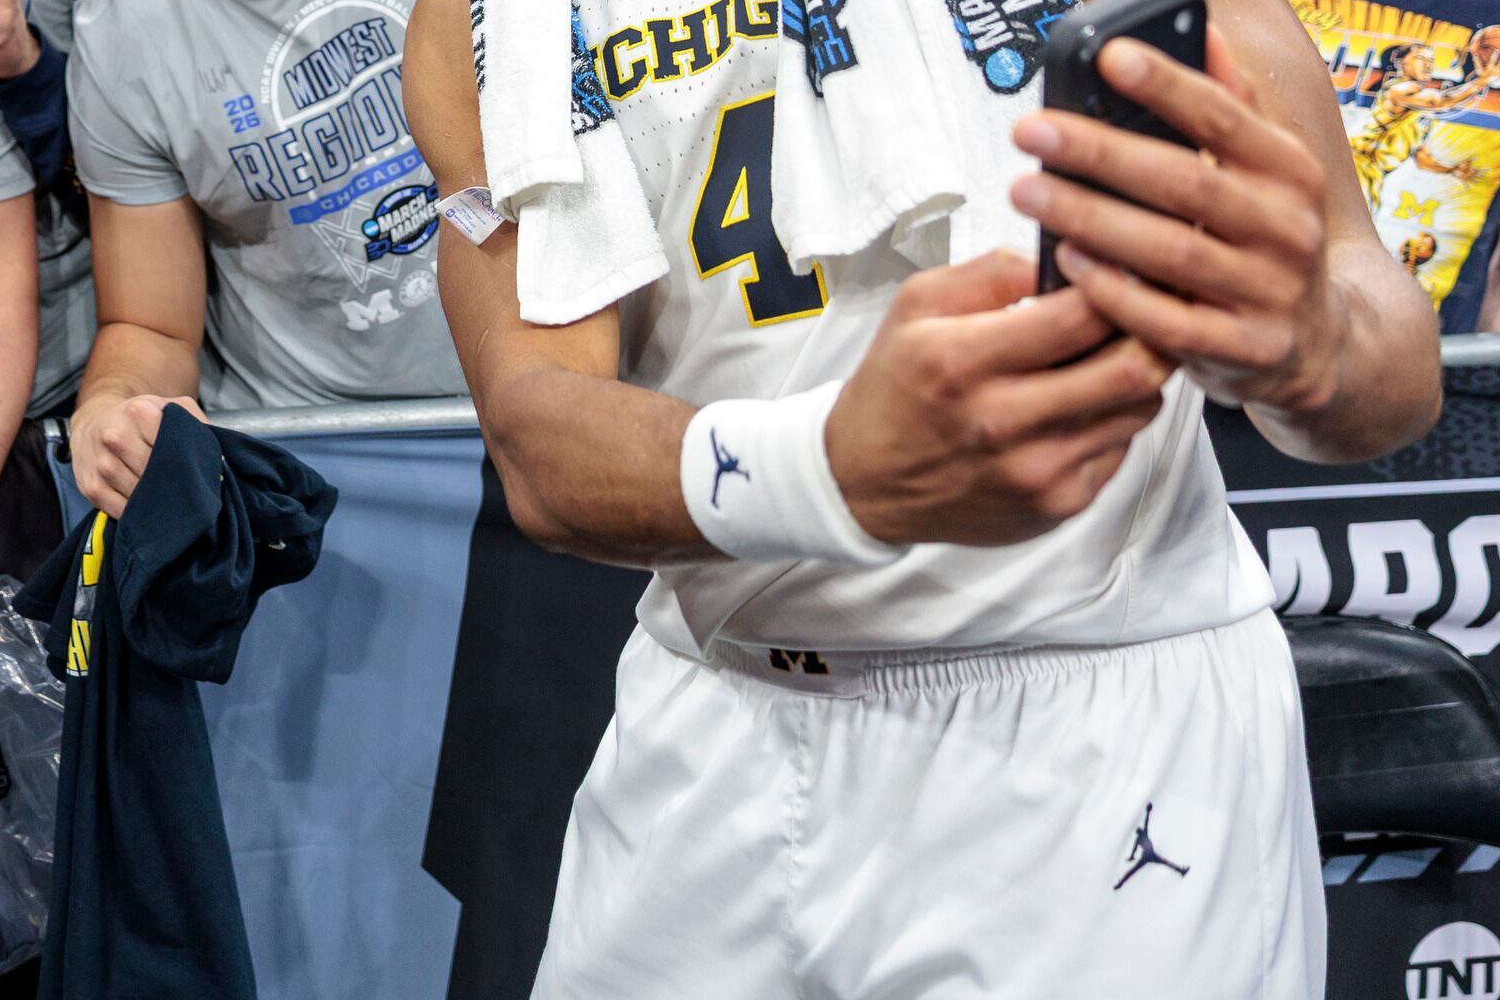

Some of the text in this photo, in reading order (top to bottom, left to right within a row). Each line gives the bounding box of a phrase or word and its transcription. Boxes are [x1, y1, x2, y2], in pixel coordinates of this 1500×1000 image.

[283, 17, 396, 110] MIDWEST
[223, 94, 256, 118] 20
[230, 111, 262, 134] 26
[320, 153, 418, 211] CHICAGO
[377, 191, 428, 233] MARCH
[687, 88, 831, 329] 4
[1393, 190, 1440, 227] M
[339, 288, 401, 332] M
[1267, 514, 1500, 658] ARC
[1405, 954, 1500, 999] TNT
